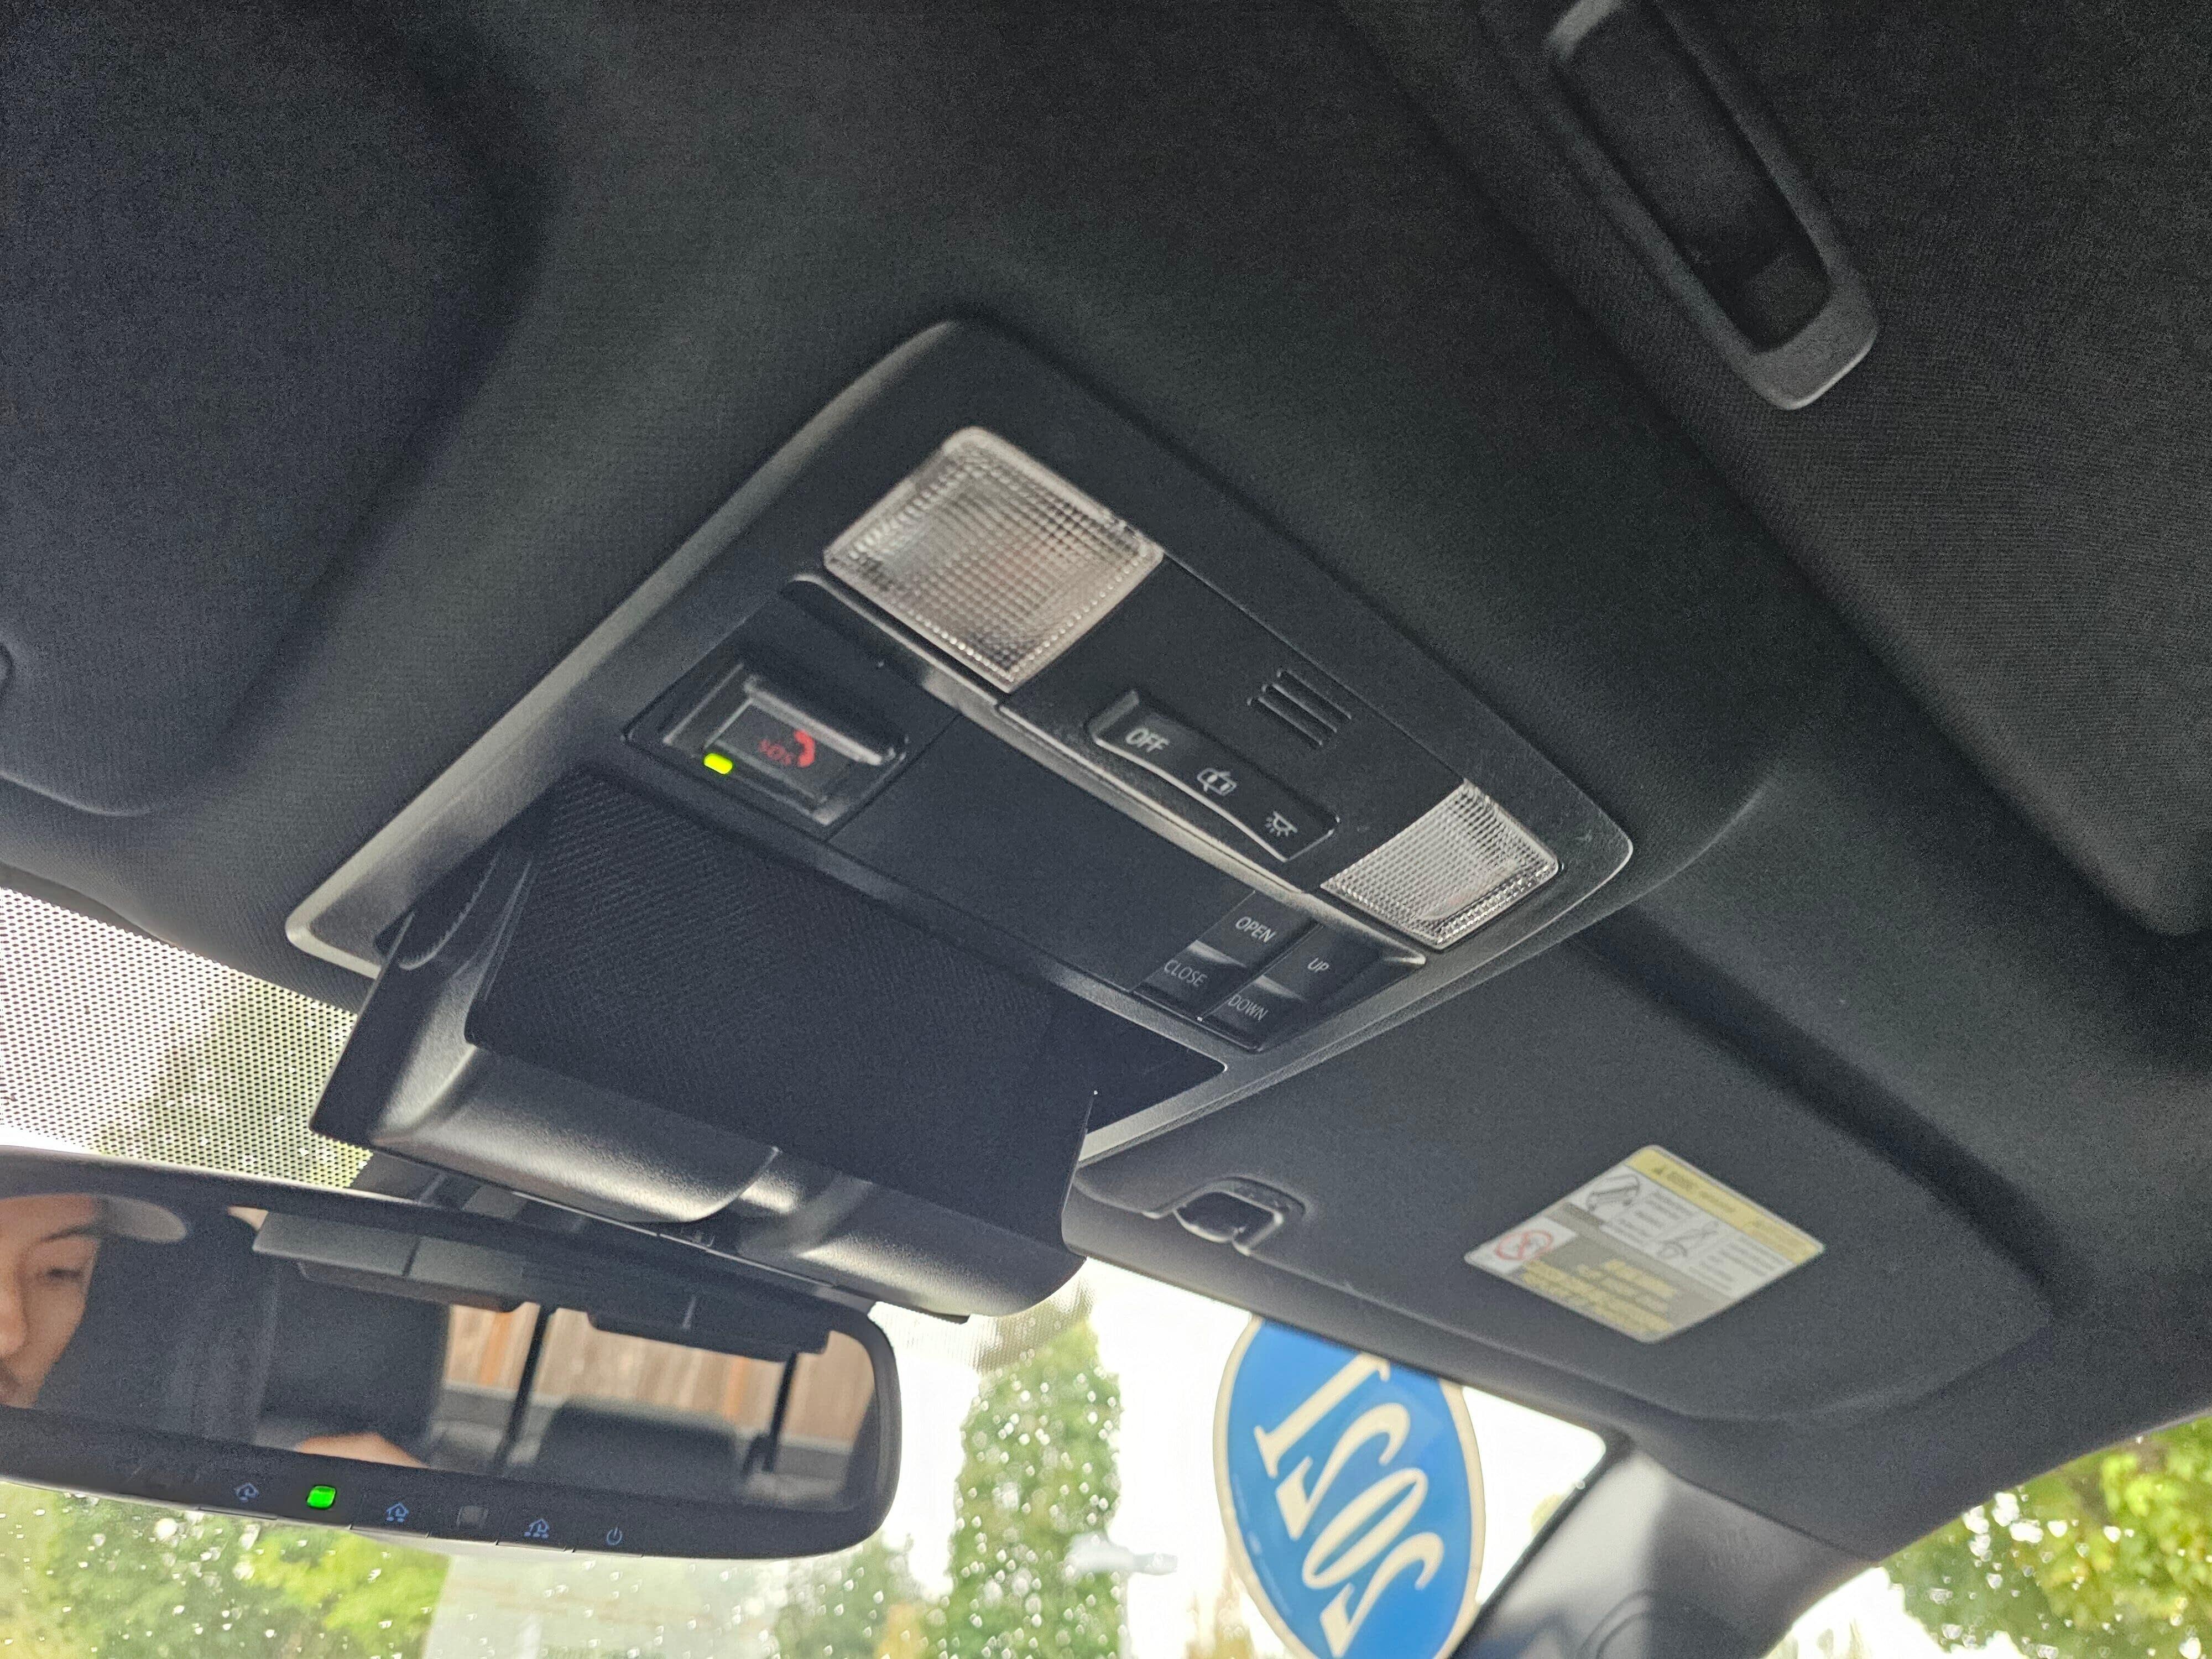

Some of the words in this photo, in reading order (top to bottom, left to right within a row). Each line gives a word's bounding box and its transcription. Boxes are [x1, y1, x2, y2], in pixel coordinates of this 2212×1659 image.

[1125, 727, 1170, 754] OFF
[1235, 916, 1277, 943] OPEN
[1164, 959, 1208, 988] CLOSE
[1308, 958, 1329, 974] UP
[1227, 994, 1268, 1022] DOWN
